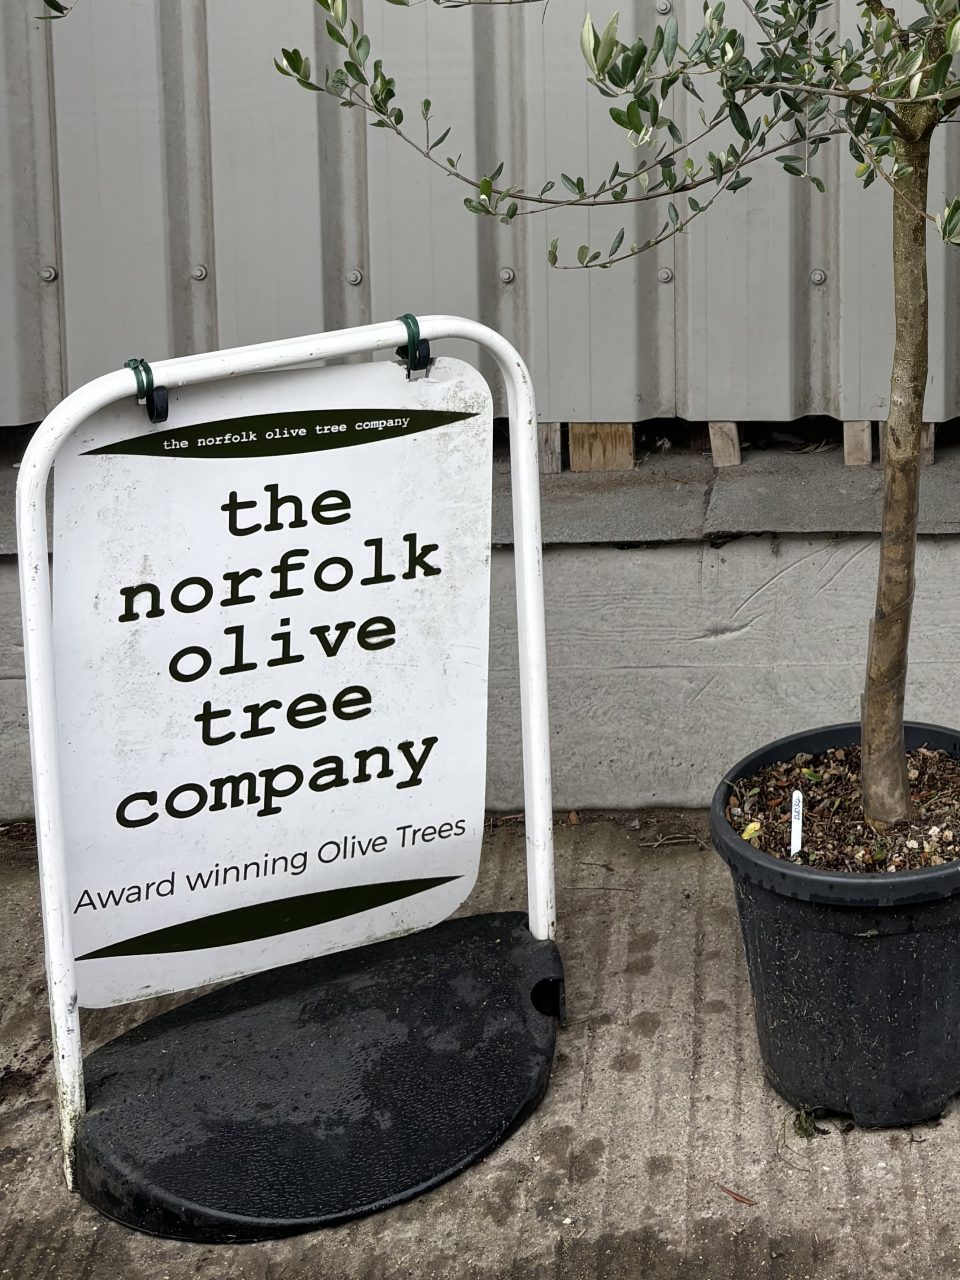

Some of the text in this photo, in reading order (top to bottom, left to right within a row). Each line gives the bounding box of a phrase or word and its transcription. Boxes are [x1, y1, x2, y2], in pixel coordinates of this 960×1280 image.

[163, 415, 411, 450] the norfolk olive tree company
[221, 484, 351, 536] the
[119, 533, 441, 622] norfolk
[169, 616, 395, 682] olive
[194, 686, 371, 746] tree
[116, 737, 438, 828] company
[74, 820, 466, 915] Award winning Olive Trees
